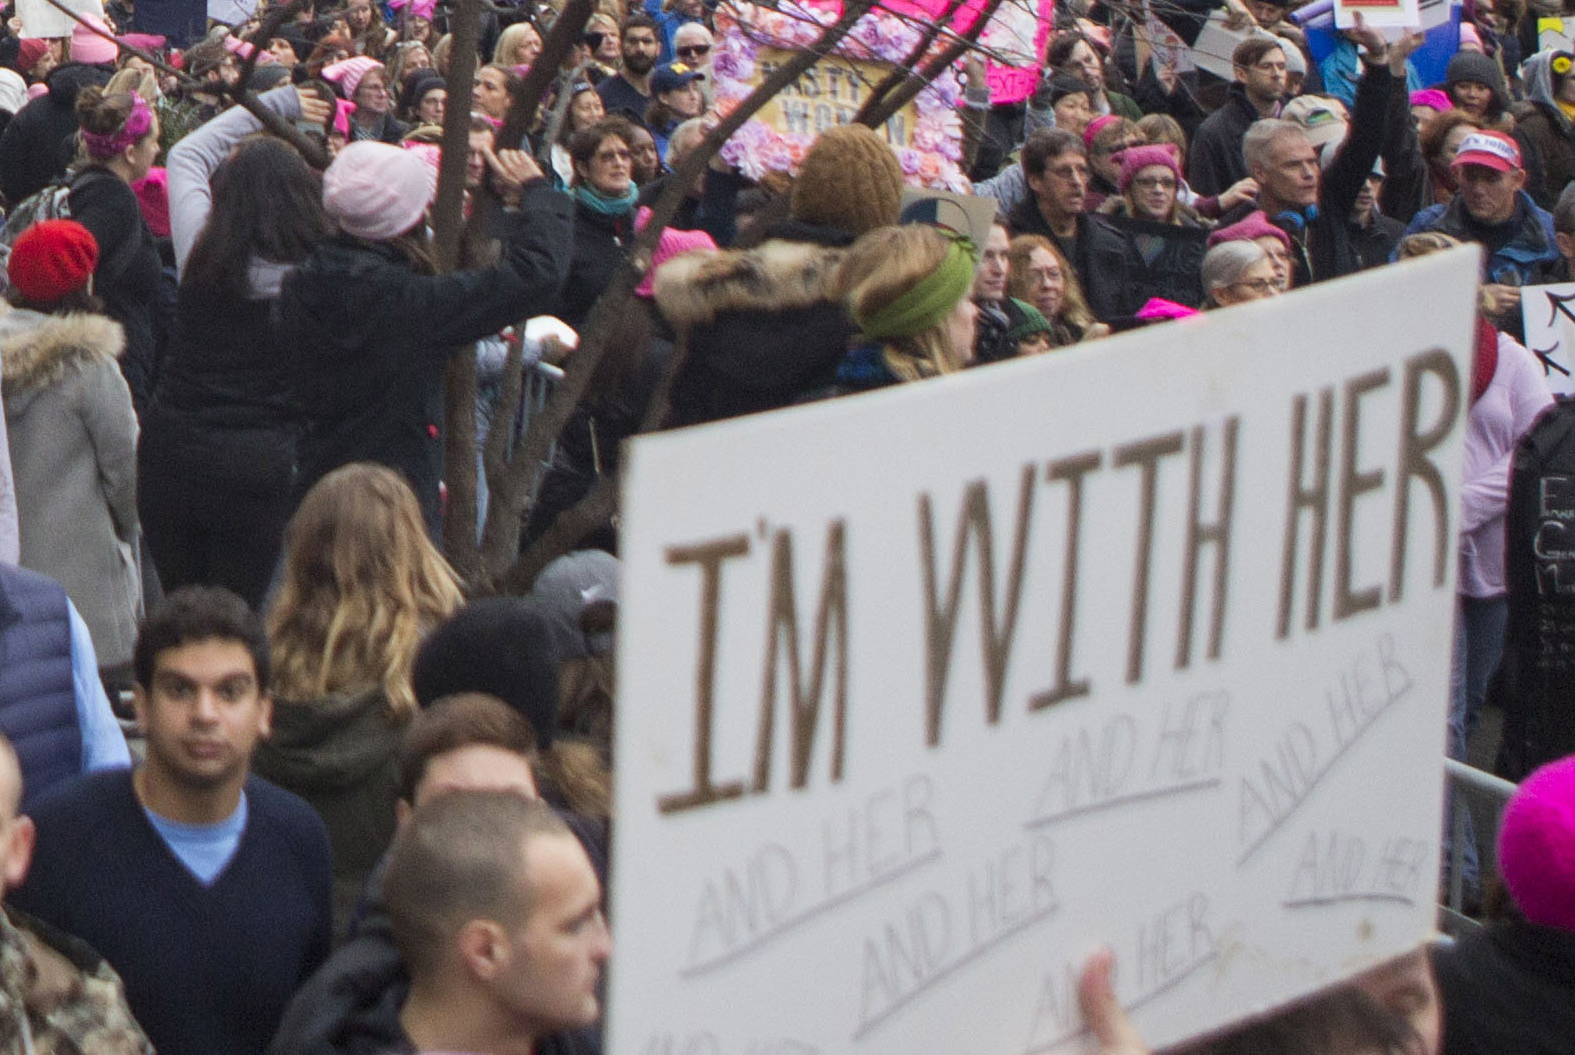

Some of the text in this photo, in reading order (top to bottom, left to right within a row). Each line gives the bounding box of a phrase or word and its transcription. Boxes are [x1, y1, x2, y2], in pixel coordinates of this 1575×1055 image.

[658, 516, 850, 817] I'M
[915, 412, 1245, 751] WITH
[1274, 346, 1463, 642] HER
[1033, 689, 1230, 819] AND HER
[1324, 631, 1415, 750] HER
[685, 772, 941, 966] AND HER
[1289, 828, 1367, 894] AND
[860, 836, 1057, 1023] AND HER
[1135, 890, 1213, 989] HER
